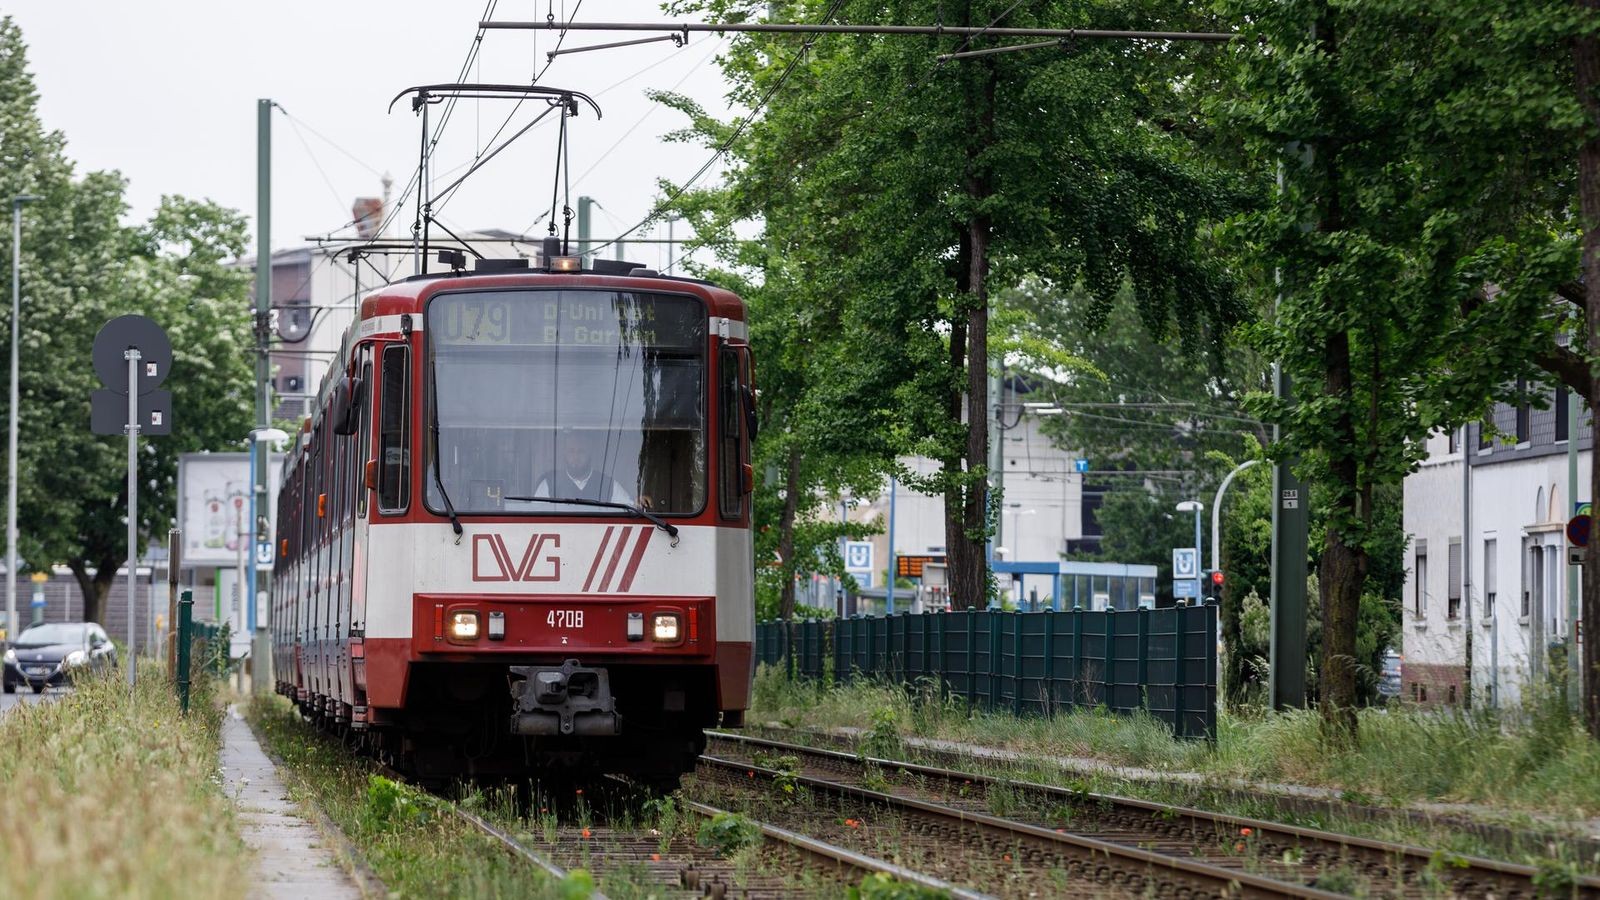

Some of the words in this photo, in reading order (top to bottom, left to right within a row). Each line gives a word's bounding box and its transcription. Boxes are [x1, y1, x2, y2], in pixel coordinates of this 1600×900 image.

[442, 302, 507, 341] U79
[543, 303, 604, 320] D-Uni
[257, 543, 272, 563] U
[472, 533, 560, 582] DVG
[851, 546, 867, 566] U
[1178, 553, 1193, 573] U
[546, 610, 584, 628] 4708
